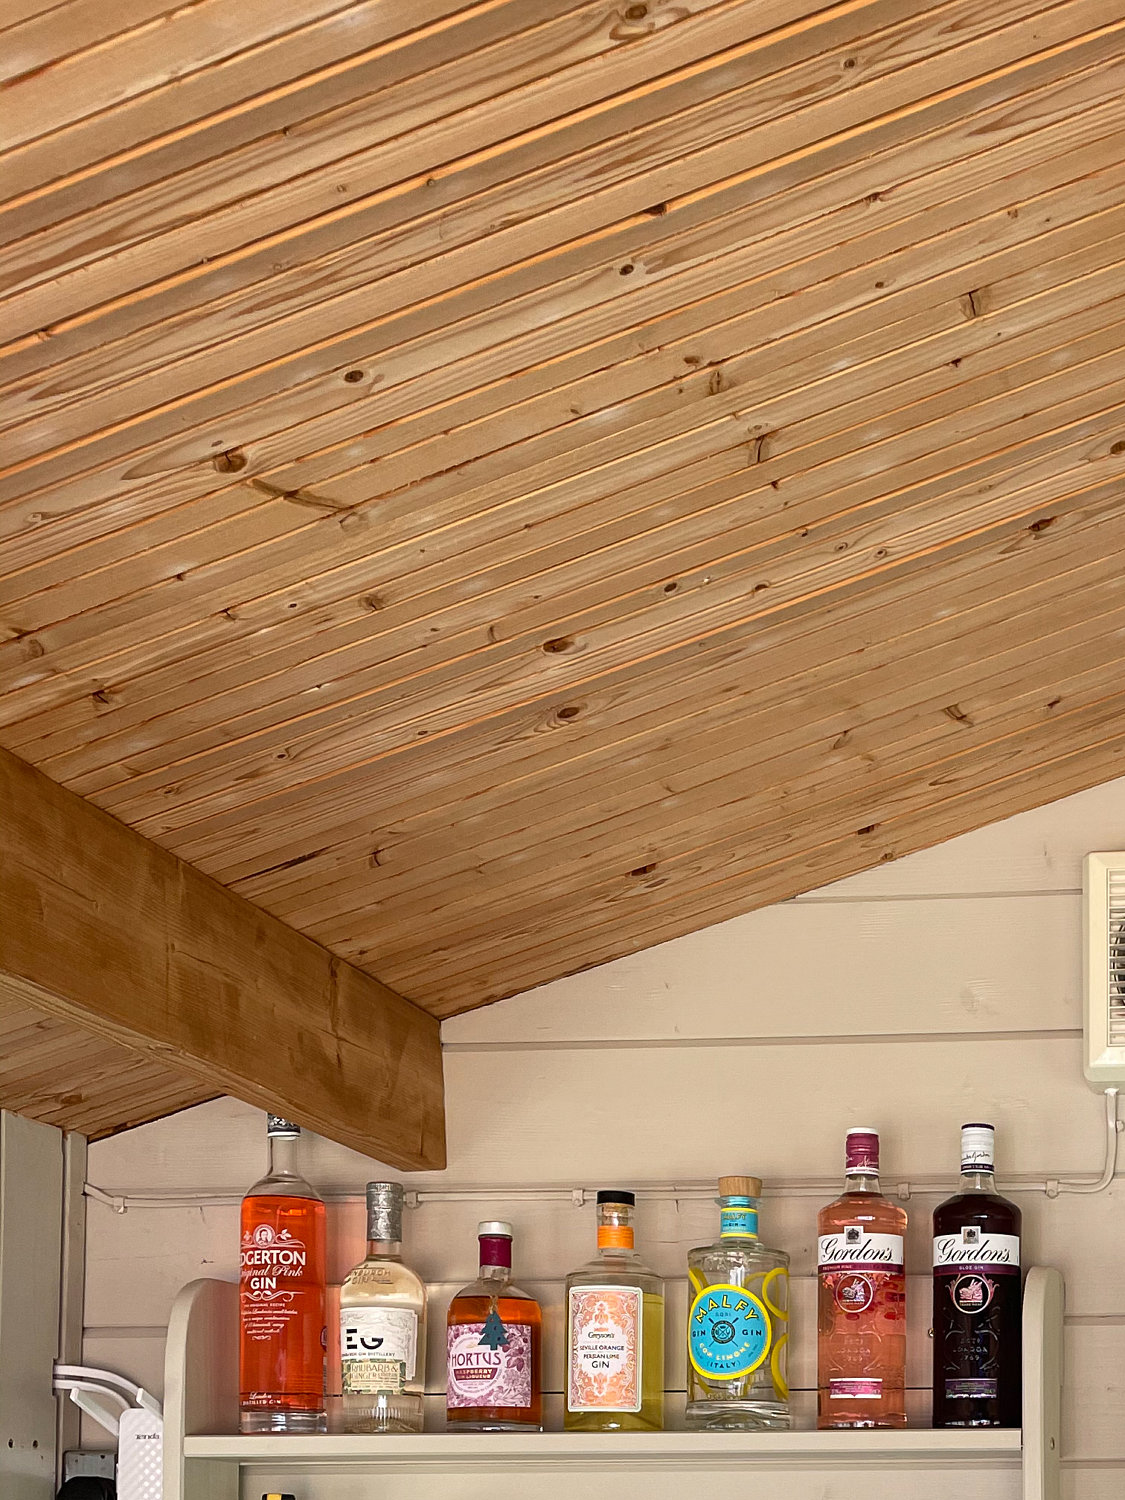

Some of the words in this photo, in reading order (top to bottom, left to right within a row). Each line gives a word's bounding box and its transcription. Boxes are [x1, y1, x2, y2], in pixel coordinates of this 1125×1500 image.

[821, 1238, 894, 1262] Gordon's
[938, 1239, 1011, 1262] Gordon's
[250, 1277, 277, 1289] GIN
[695, 1295, 759, 1323] MALFY
[452, 1352, 501, 1367] HORTUS
